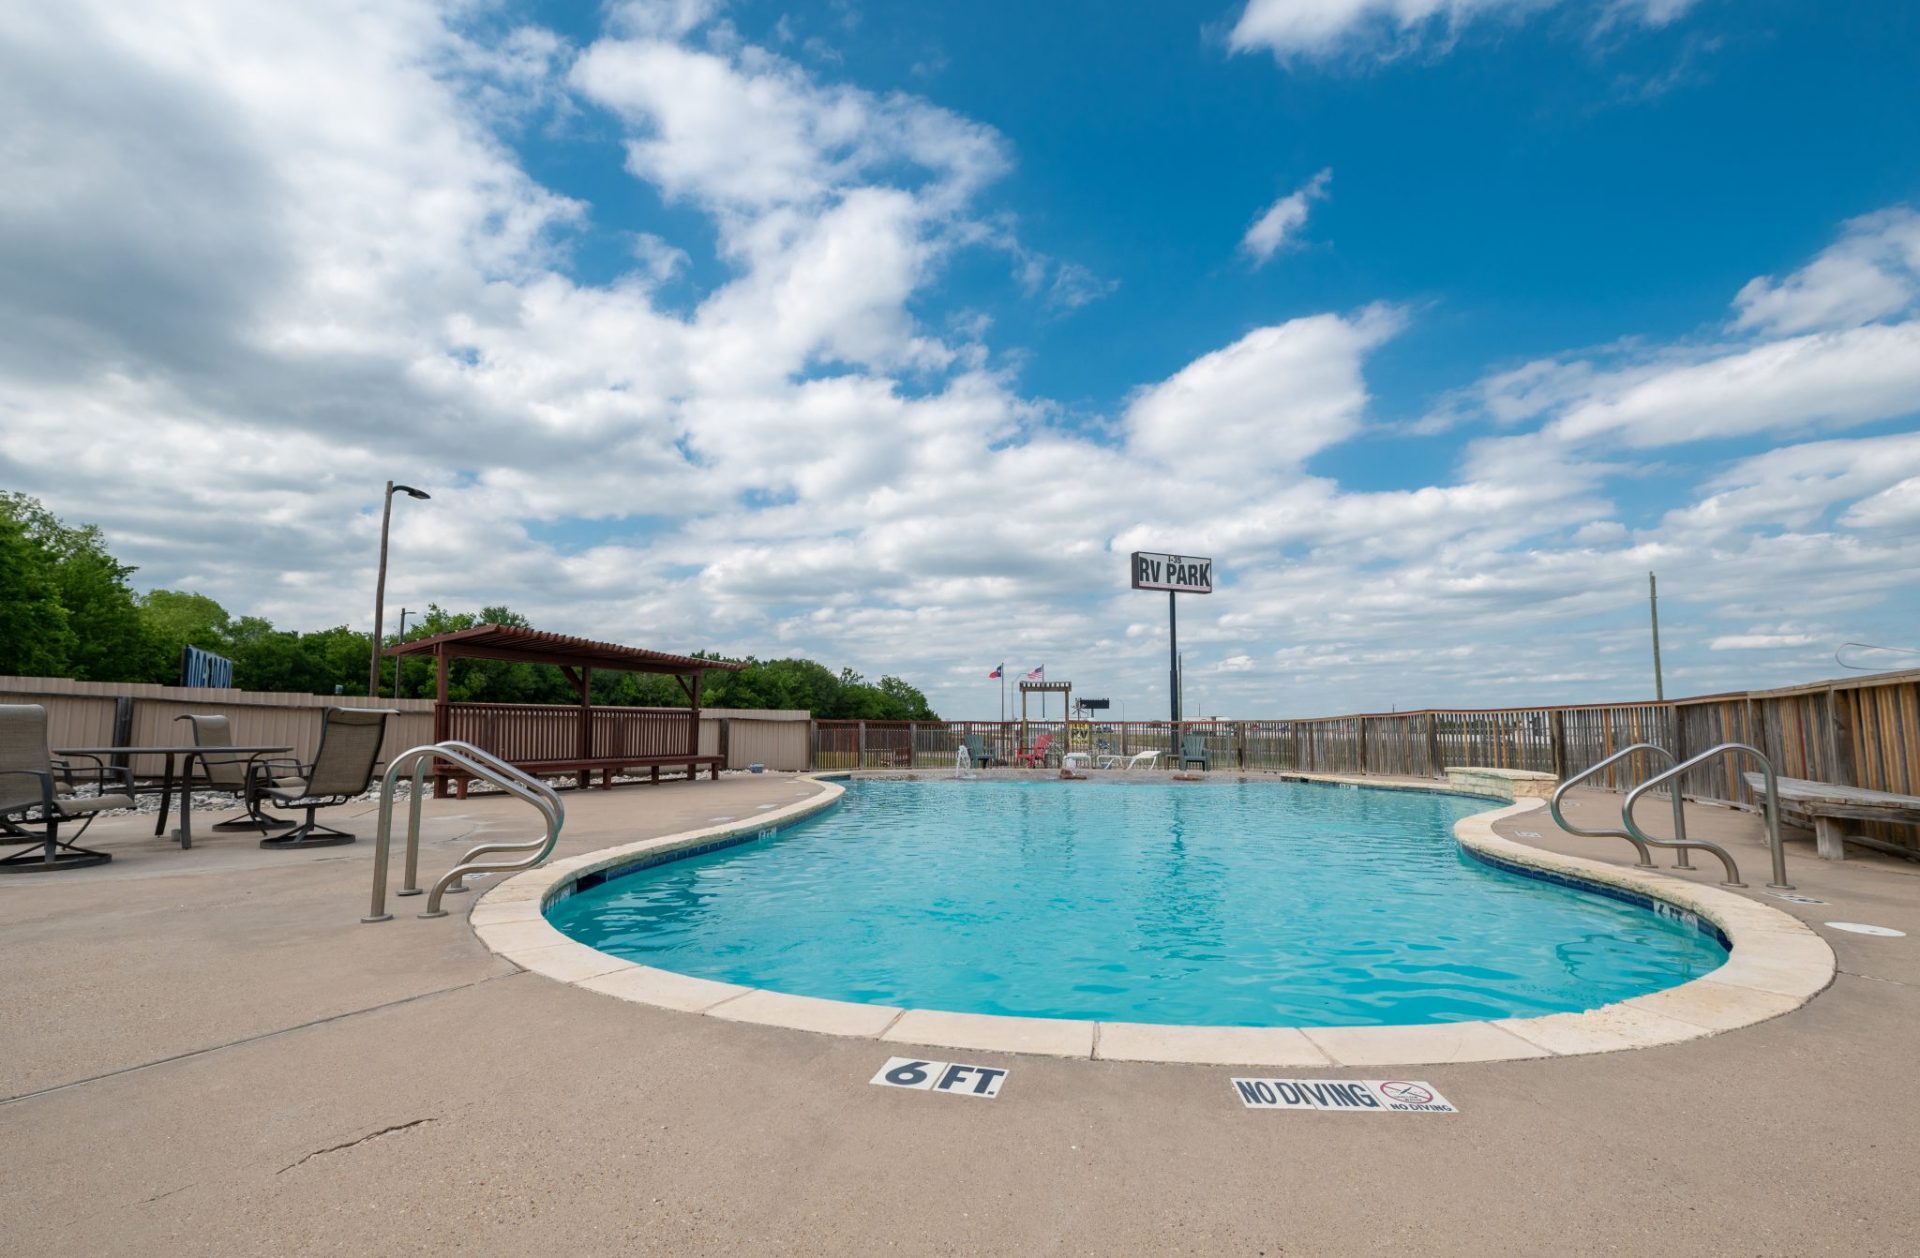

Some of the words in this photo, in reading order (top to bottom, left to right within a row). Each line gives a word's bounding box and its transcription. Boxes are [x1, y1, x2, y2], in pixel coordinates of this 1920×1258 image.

[1139, 556, 1161, 583] RV
[1166, 562, 1211, 587] PARK
[885, 1061, 931, 1086] 6
[1236, 1081, 1278, 1105] NO
[1274, 1082, 1380, 1108] DIVING
[1389, 1103, 1409, 1111] NO
[1408, 1103, 1452, 1112] DIVING
